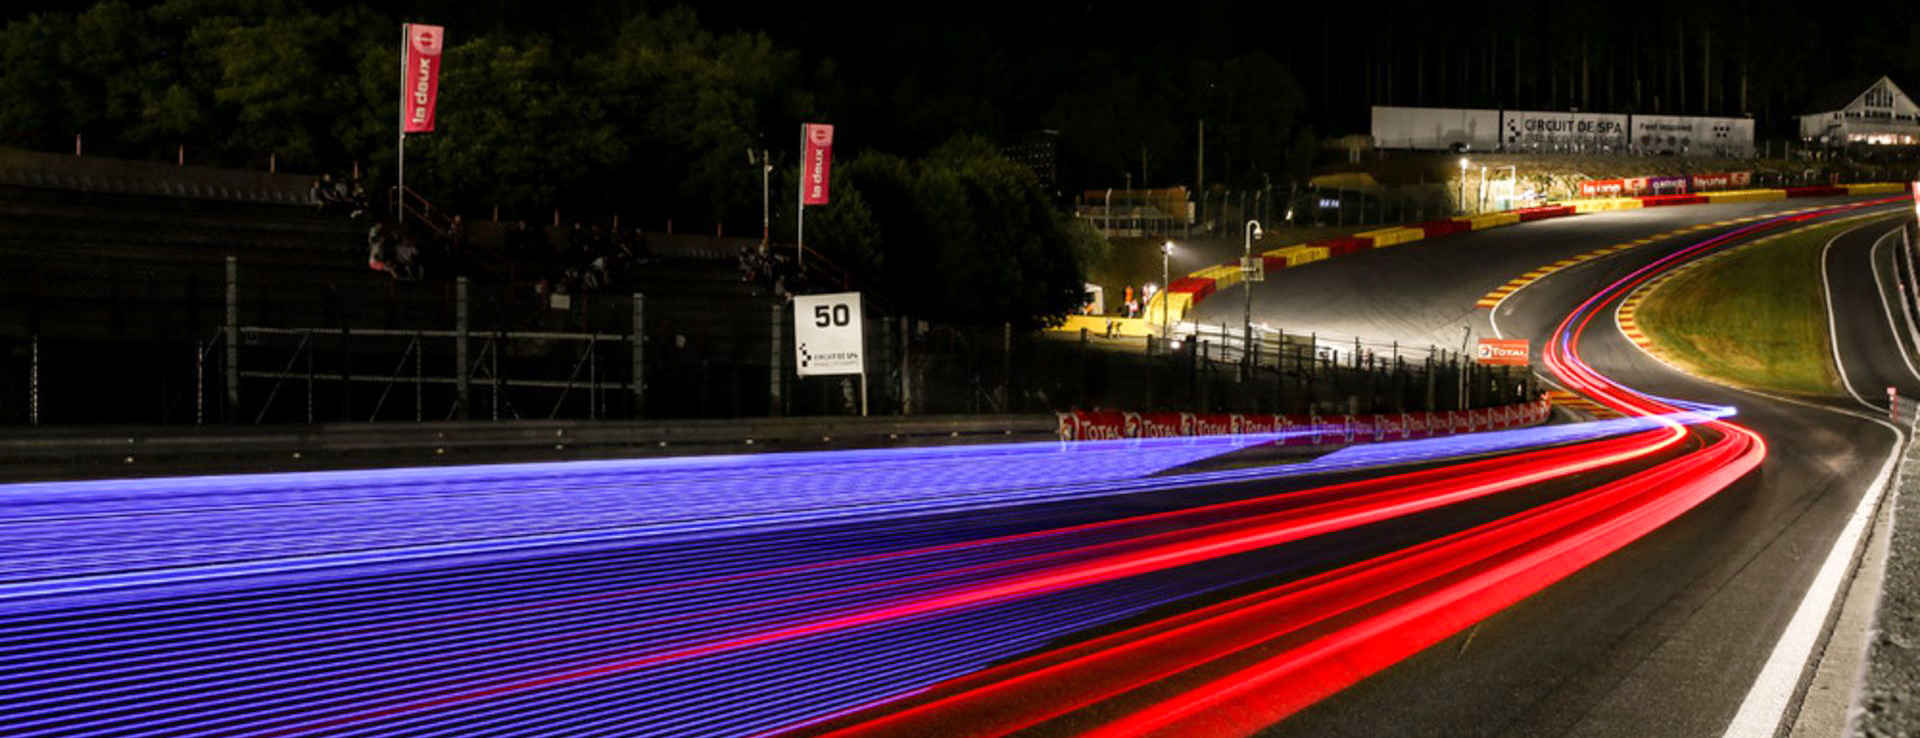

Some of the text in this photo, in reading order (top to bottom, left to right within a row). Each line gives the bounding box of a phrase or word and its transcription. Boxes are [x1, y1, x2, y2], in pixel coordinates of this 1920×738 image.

[1524, 118, 1623, 133] CIRCUIT DE SPA
[815, 303, 850, 328] 50
[1081, 420, 1122, 440] TOTAL
[1143, 419, 1177, 437] TOTAL
